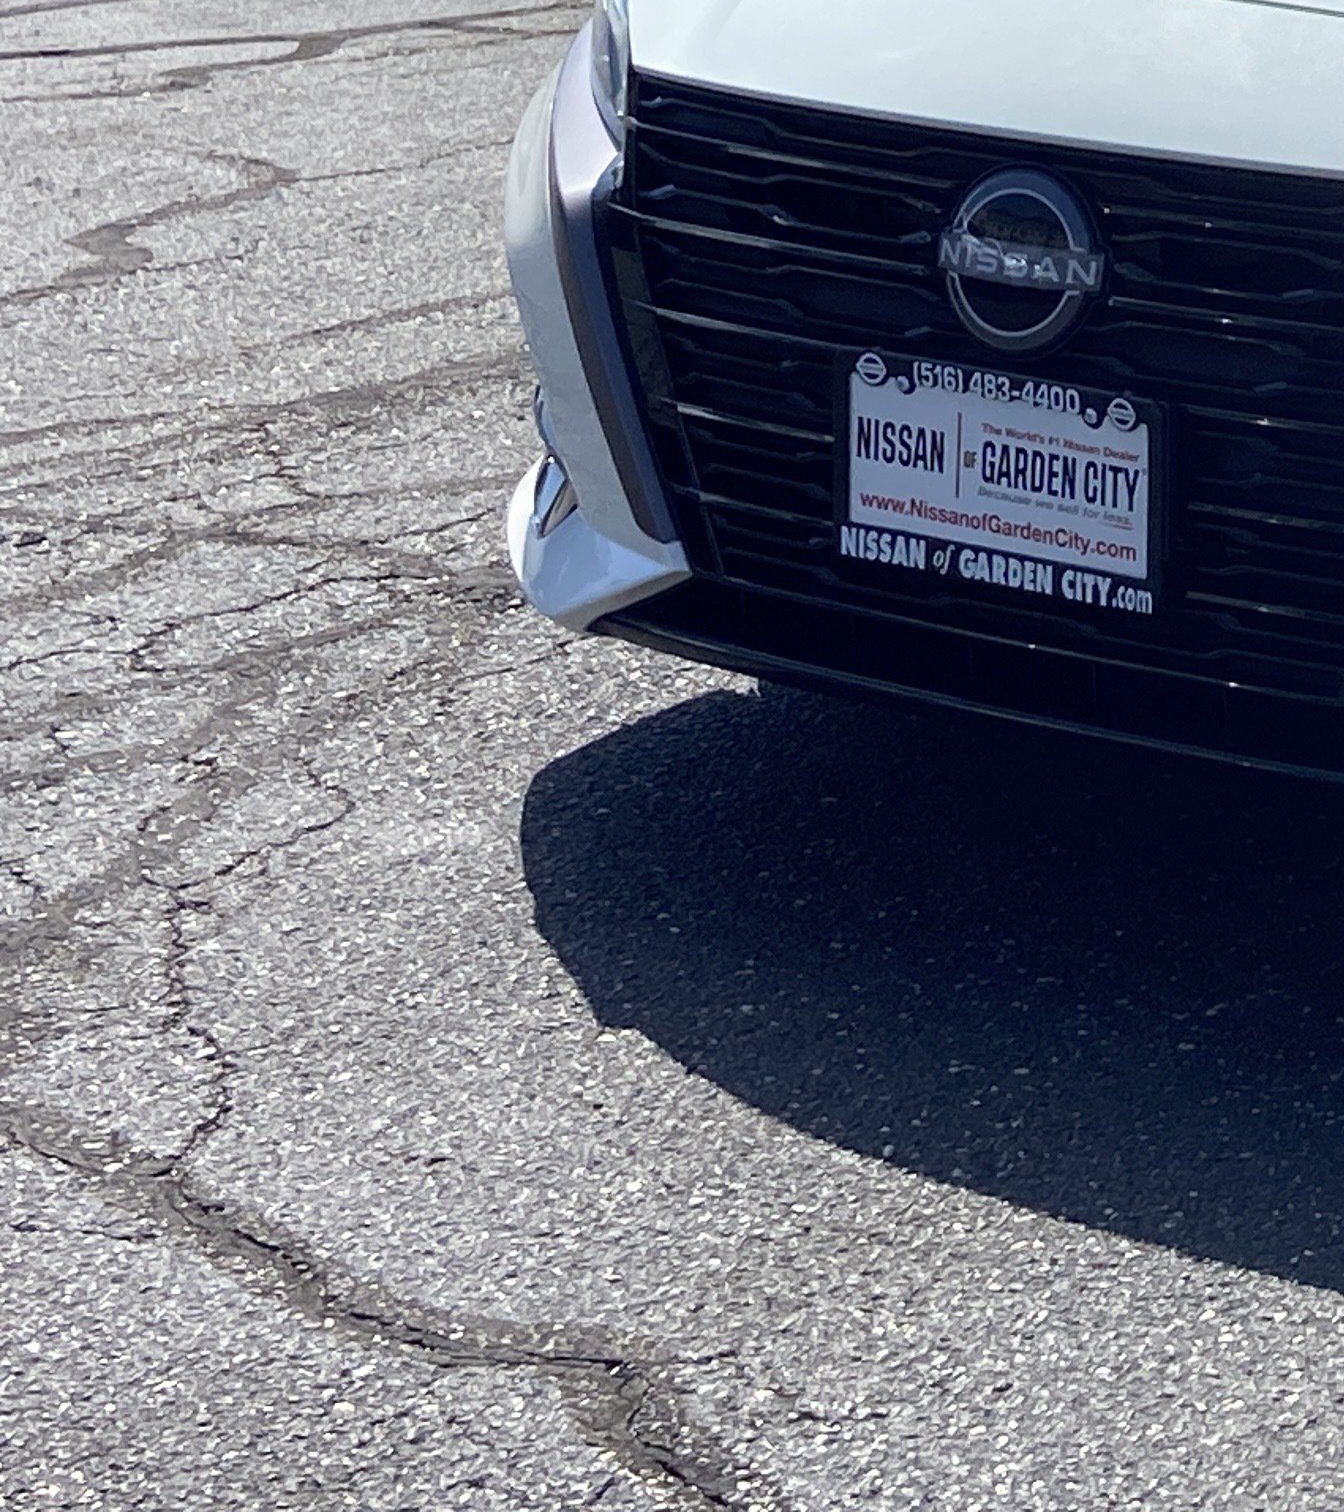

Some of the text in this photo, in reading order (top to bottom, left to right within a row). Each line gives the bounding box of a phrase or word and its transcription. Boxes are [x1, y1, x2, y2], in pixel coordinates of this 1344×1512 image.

[938, 237, 1098, 286] NISSAN
[913, 360, 1081, 414] (516) 483-4400
[856, 416, 1142, 512] NISSAN OF GARDEN CITY
[981, 422, 1003, 436] The
[1005, 427, 1045, 446] World's
[1063, 437, 1101, 455] Nissan
[1103, 446, 1141, 463] Dealer
[859, 491, 1138, 562] www.NissanofGardenCity.com
[978, 485, 1032, 505] Because
[1035, 498, 1054, 510] we
[1057, 502, 1079, 515] sell
[1082, 506, 1100, 519] for
[840, 525, 1153, 615] NISSAN of GARDEN CITY.com
